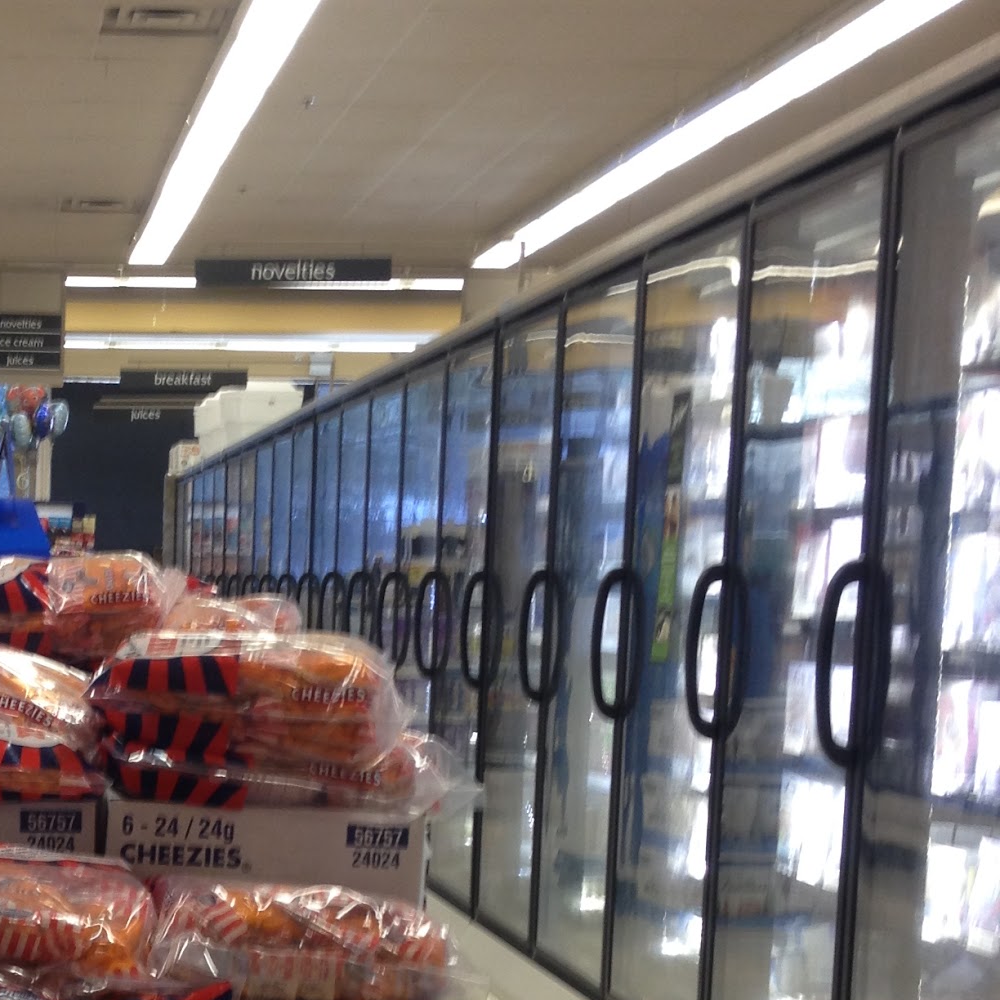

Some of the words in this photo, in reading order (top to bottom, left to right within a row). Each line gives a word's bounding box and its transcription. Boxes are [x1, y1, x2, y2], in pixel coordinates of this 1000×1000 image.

[251, 260, 335, 281] novelties
[0, 318, 42, 330] novelties
[13, 338, 44, 348] cream
[6, 354, 35, 366] juices
[154, 371, 212, 386] breakfast
[131, 408, 161, 421] juices
[27, 811, 75, 830] 56757
[122, 816, 134, 837] 6
[155, 817, 179, 837] 24
[199, 817, 234, 844] 24g
[119, 844, 241, 868] CHEEZIES
[352, 852, 400, 870] 24024
